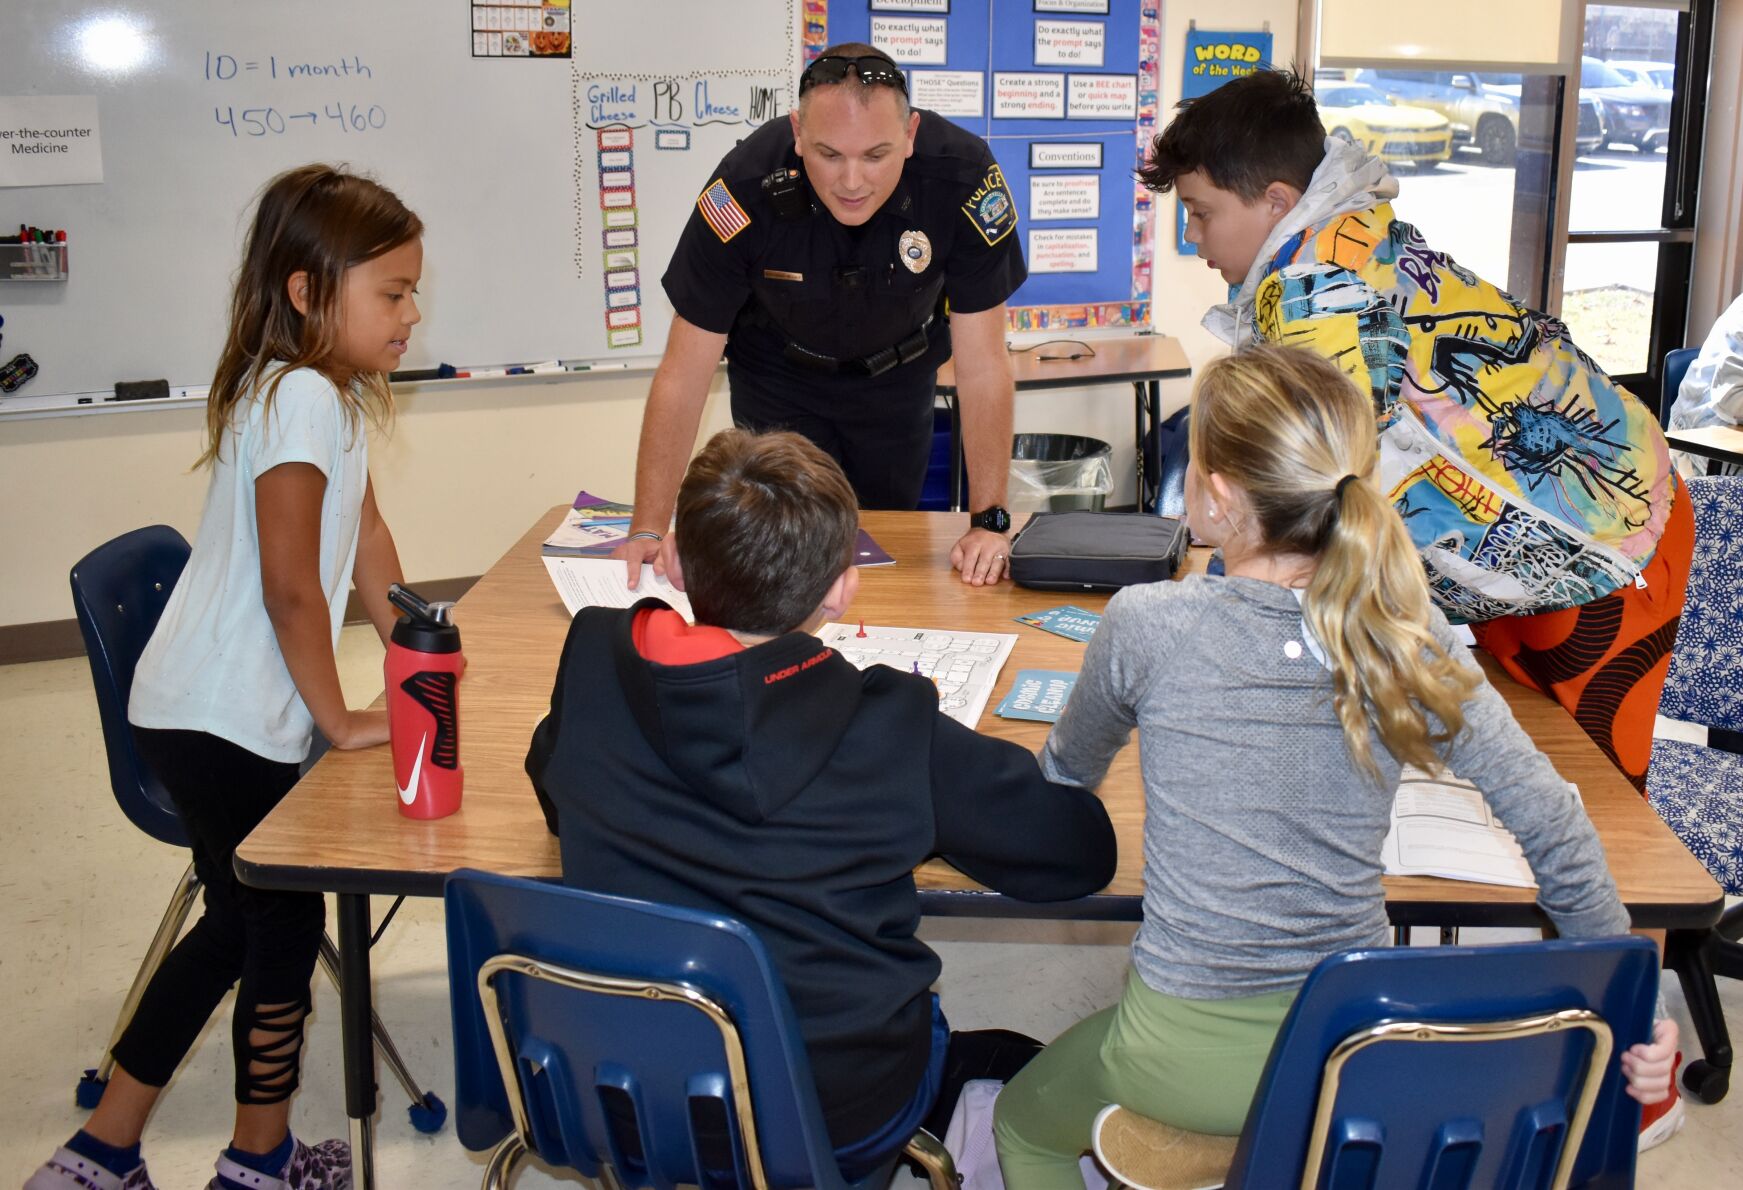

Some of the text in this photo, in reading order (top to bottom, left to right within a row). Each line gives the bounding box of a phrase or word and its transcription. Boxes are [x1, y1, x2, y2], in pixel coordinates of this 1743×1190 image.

[874, 22, 943, 33] Do exactly what
[1052, 26, 1080, 37] exactly
[1082, 27, 1102, 36] what
[874, 35, 943, 48] the prompt says
[1038, 38, 1102, 50] the prompt says
[907, 48, 921, 56] do!
[1068, 50, 1081, 58] do!
[1194, 43, 1261, 63] WORD
[205, 51, 238, 80] 10
[288, 56, 372, 79] month
[1192, 63, 1206, 75] of
[1209, 63, 1229, 76] the
[999, 78, 1026, 86] Create
[1034, 79, 1060, 88] strong
[586, 84, 637, 104] Grilled
[694, 79, 740, 119] Cheese
[997, 88, 1038, 99] beginning
[1039, 90, 1054, 98] and
[653, 80, 683, 122] PB
[1000, 101, 1026, 110] strong
[590, 103, 637, 124] Cheese
[1096, 104, 1110, 112] you
[215, 102, 387, 137] 450 460
[11, 142, 69, 155] Medicine
[1038, 151, 1096, 161] Conventions
[1033, 233, 1053, 241] Check
[764, 664, 800, 685] UNDER
[1038, 679, 1069, 713] CLEANUP
